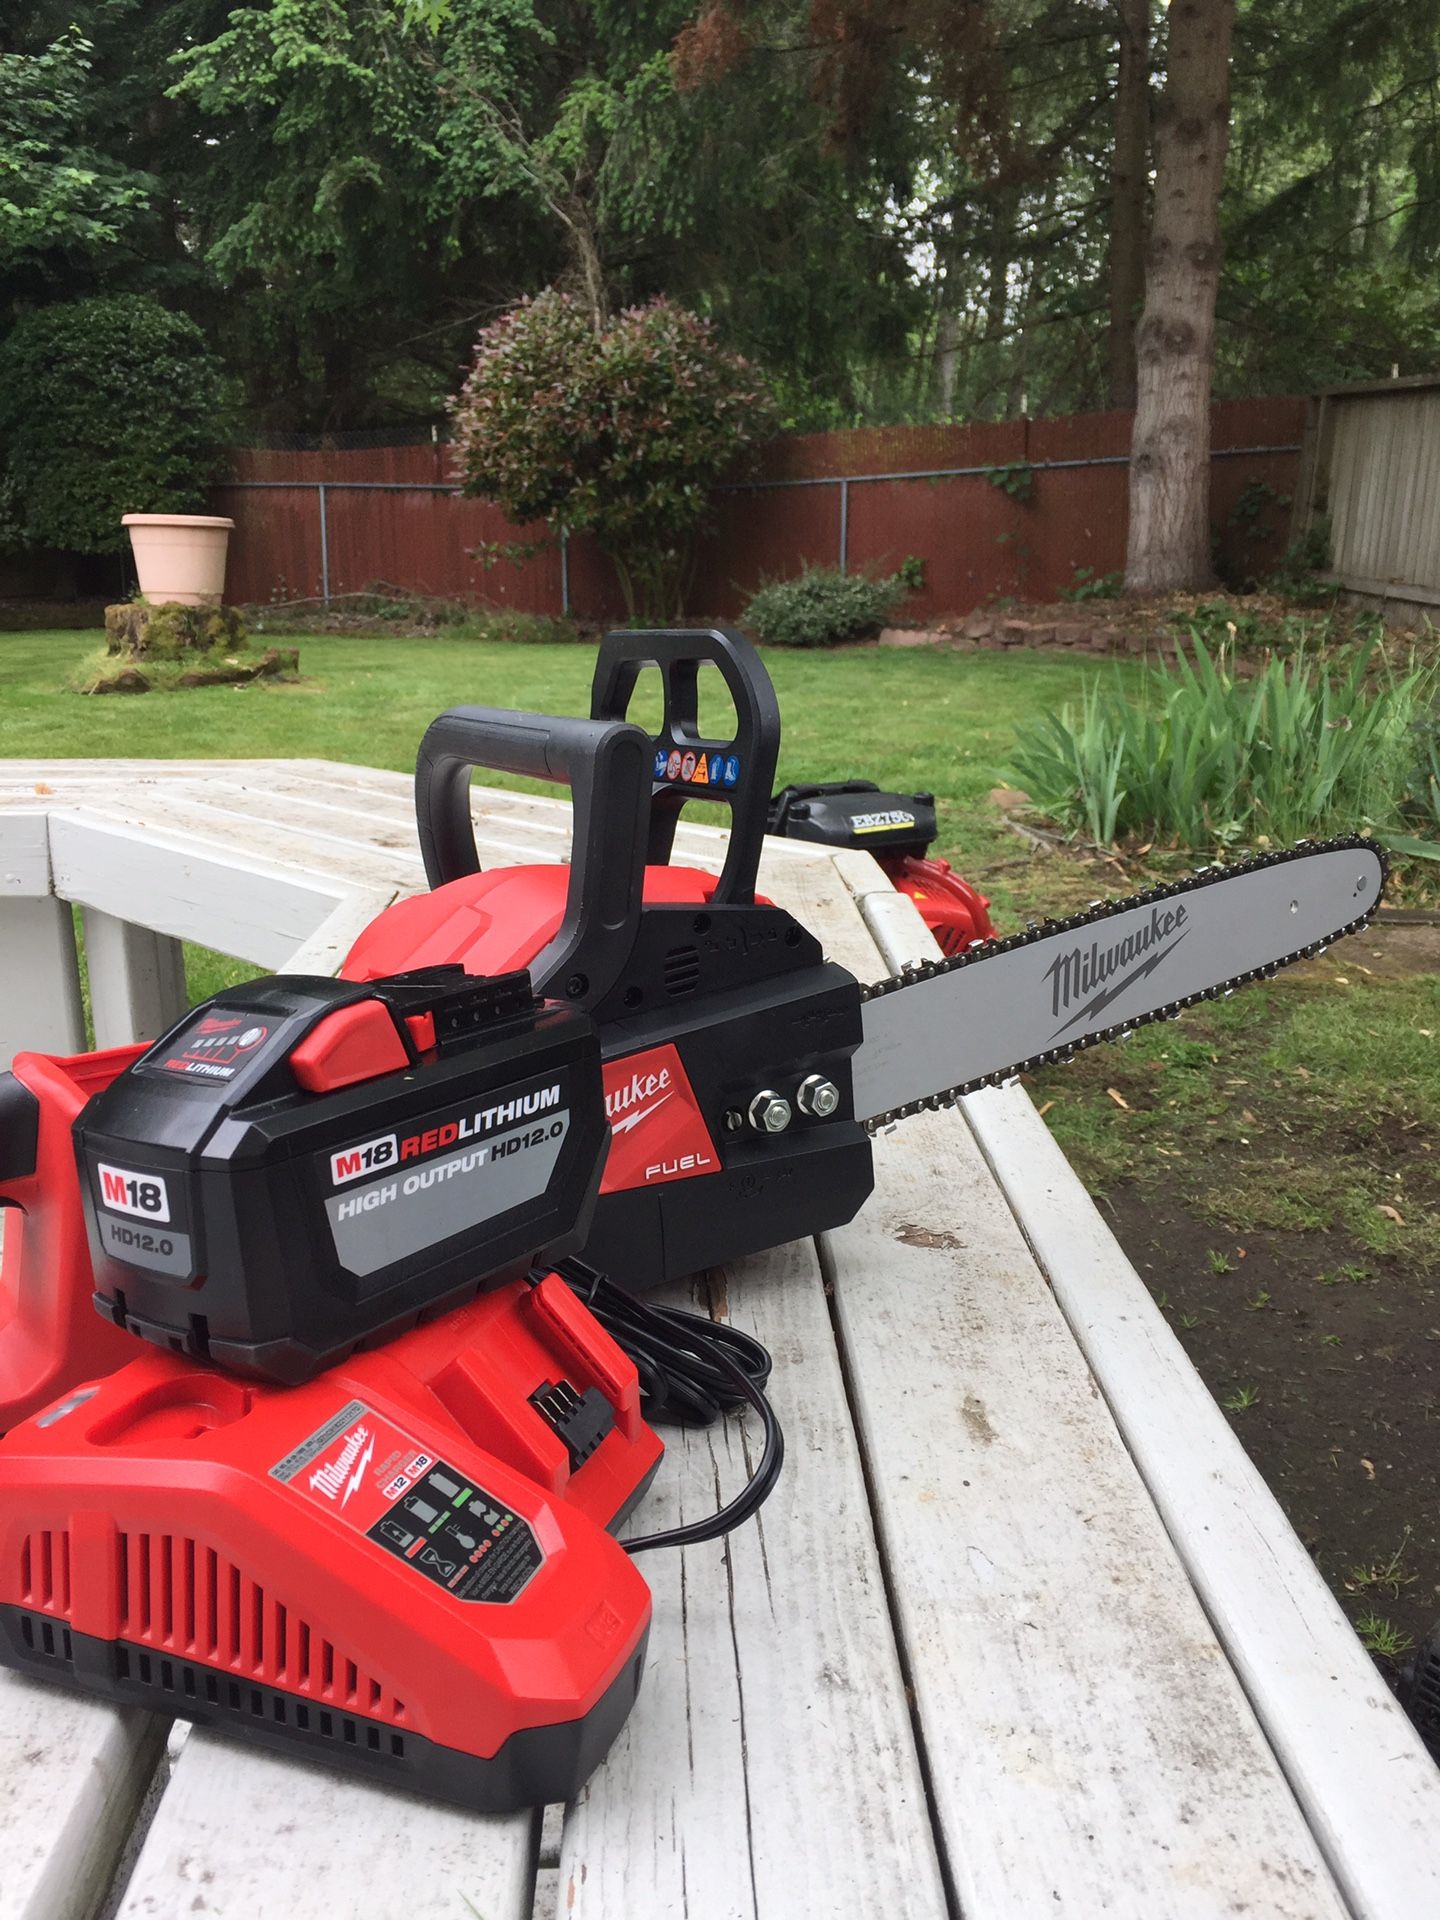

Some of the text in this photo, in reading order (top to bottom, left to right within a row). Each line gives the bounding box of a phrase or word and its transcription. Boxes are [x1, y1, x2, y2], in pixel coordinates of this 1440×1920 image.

[1042, 904, 1189, 1017] Milwaukee
[165, 1059, 235, 1077] REDLITHIUM
[336, 1085, 561, 1179] M18 REDLITHIUM
[338, 1121, 563, 1222] HIGH OUTPUT HD12.0
[645, 1153, 710, 1180] FUEL
[103, 1171, 162, 1213] M18
[111, 1224, 174, 1256] HD12.0
[309, 1424, 369, 1500] Milwaukee
[386, 1456, 428, 1497] M12 M18
